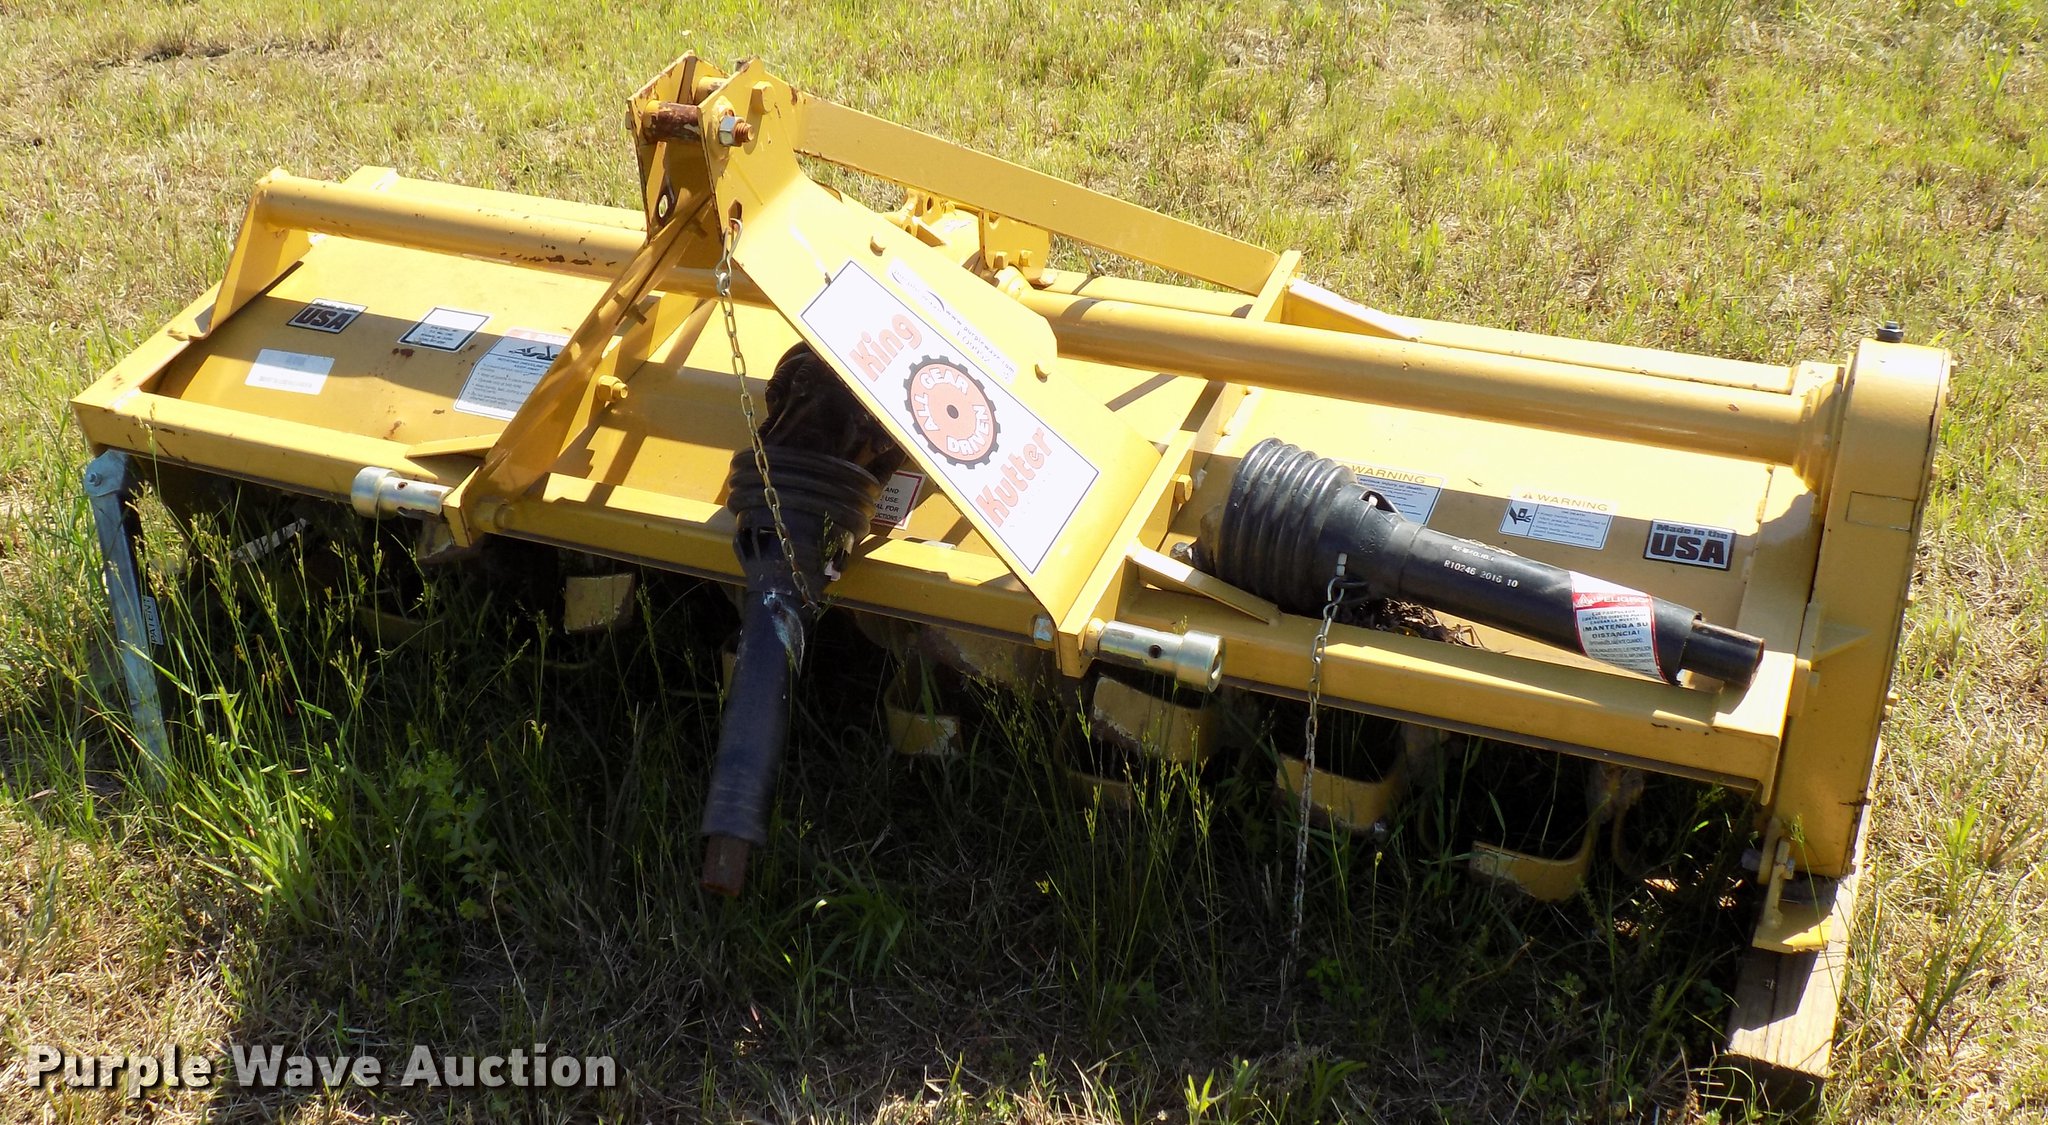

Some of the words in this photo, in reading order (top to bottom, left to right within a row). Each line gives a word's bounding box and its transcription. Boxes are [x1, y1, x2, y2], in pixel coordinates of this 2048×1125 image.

[294, 307, 353, 330] USA
[849, 314, 922, 382] King
[920, 367, 968, 395] GEAR
[914, 392, 940, 432] ALL
[946, 404, 990, 456] DRIVEN
[975, 427, 1052, 528] Kutter
[1352, 465, 1426, 484] WARNING
[1537, 494, 1608, 512] WARNING
[1656, 524, 1691, 534] Made
[1693, 528, 1705, 536] in
[1708, 530, 1728, 540] the
[1650, 532, 1725, 565] USA
[1444, 559, 1477, 575] R10246
[1479, 570, 1503, 583] 2016
[1507, 579, 1518, 588] 10
[1592, 630, 1640, 639] DISTANCIA!
